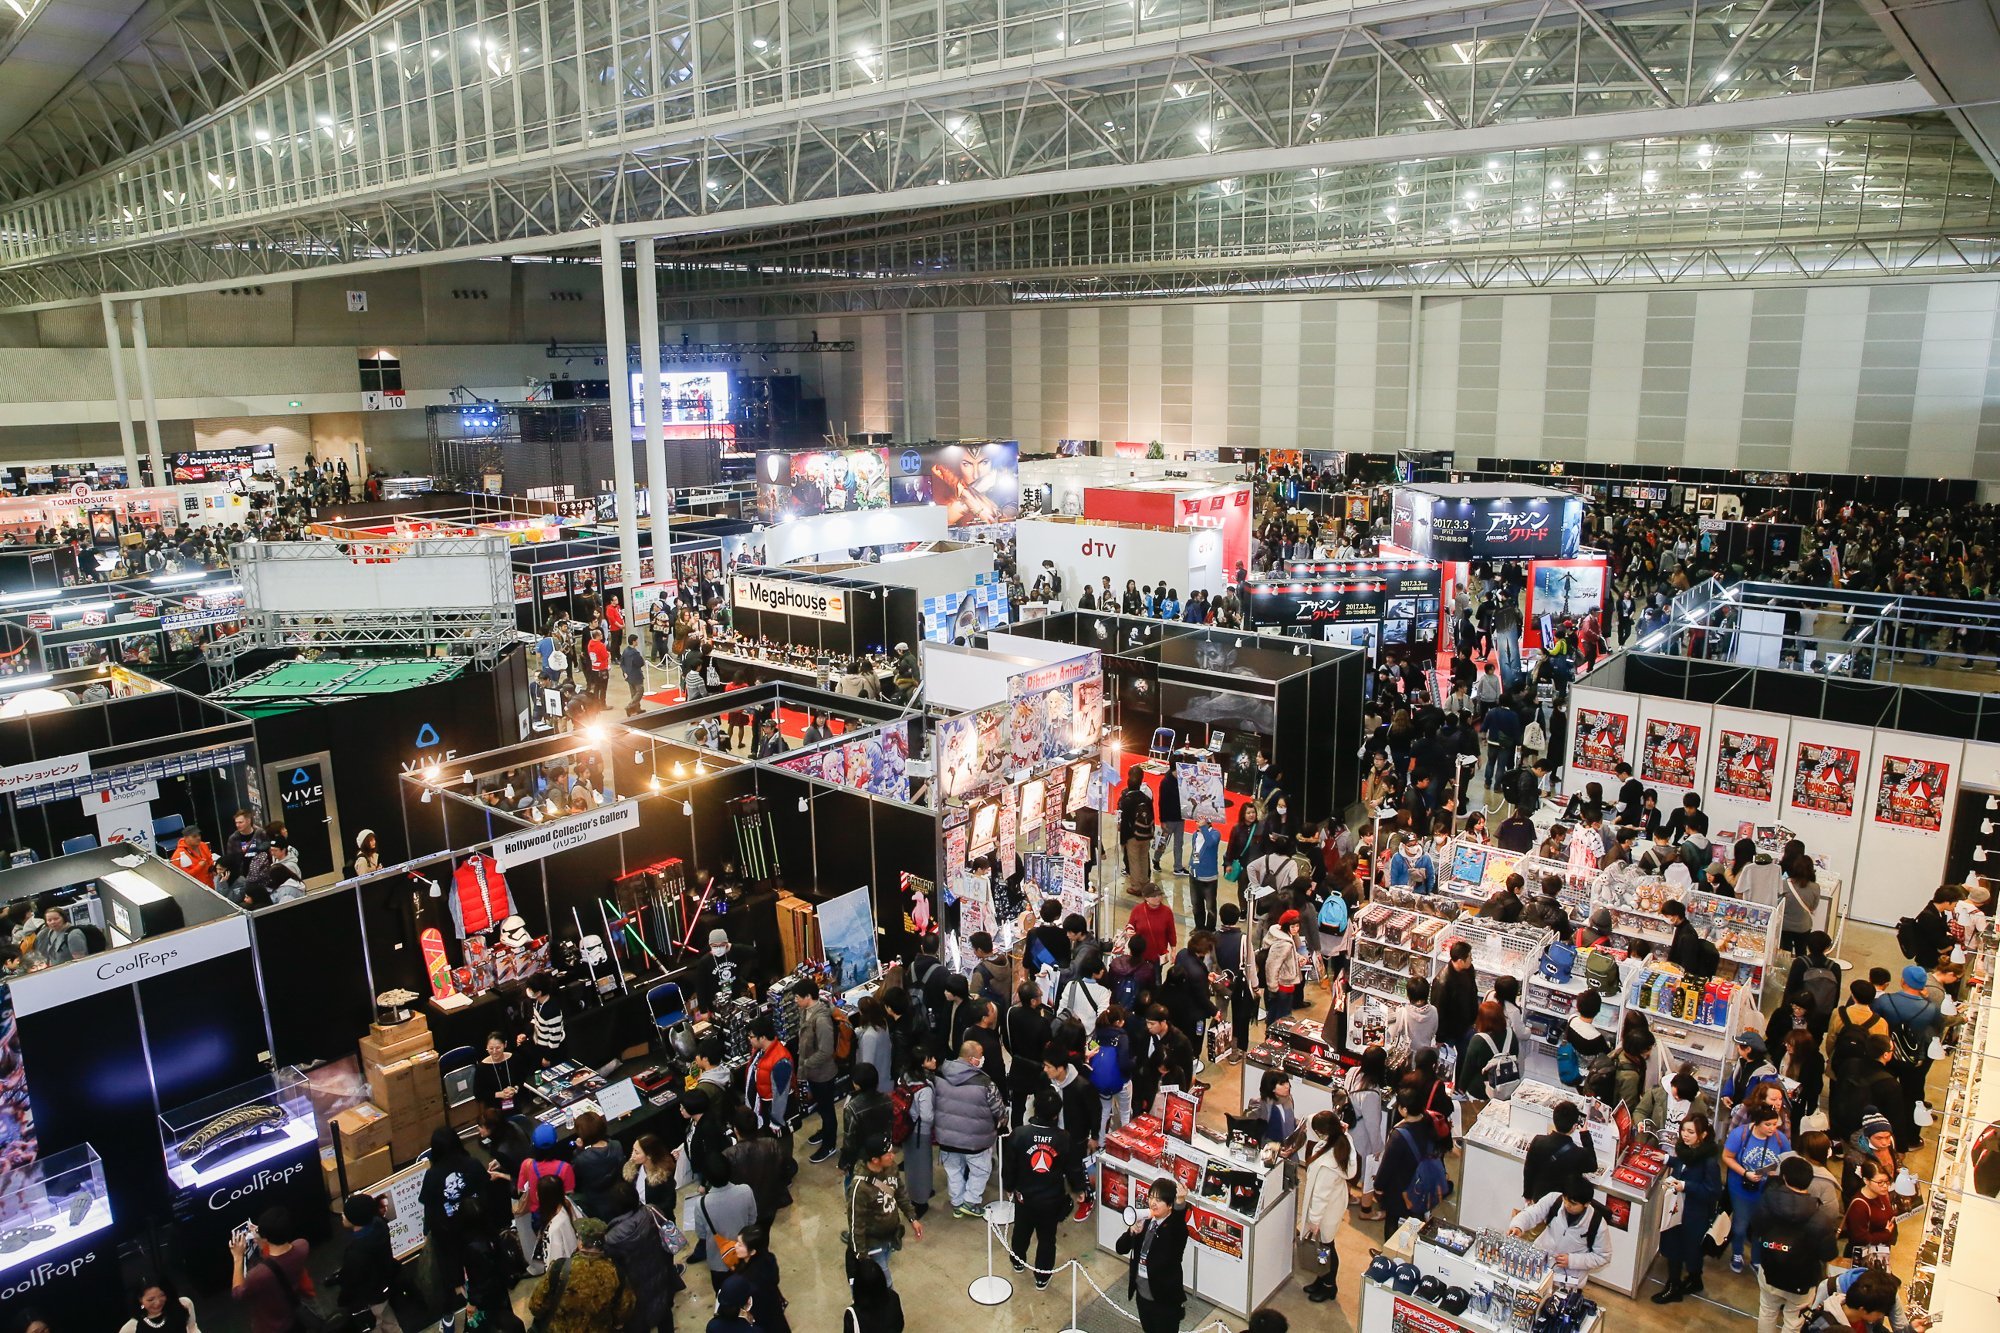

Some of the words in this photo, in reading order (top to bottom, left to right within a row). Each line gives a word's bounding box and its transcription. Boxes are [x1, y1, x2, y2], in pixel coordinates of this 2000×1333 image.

[388, 396, 402, 408] 10
[190, 456, 228, 465] Domino's
[229, 455, 252, 463] Pizza
[901, 456, 920, 470] DC
[52, 496, 114, 506] TOMENOSUKE
[1433, 518, 1469, 530] 2017.3.3
[1486, 512, 1549, 534] アサシン
[1510, 528, 1548, 542] クリード
[1082, 538, 1116, 559] dTV
[750, 582, 827, 611] MegaHouse
[1296, 600, 1340, 616] アサシン
[1312, 610, 1340, 620] クリード
[85, 613, 104, 625] 8%
[1060, 664, 1084, 680] Anime
[0, 763, 79, 786] ネットショッピング
[113, 788, 146, 800] shopping
[282, 784, 322, 802] VIVE
[504, 832, 551, 854] Hollywood
[552, 818, 598, 840] Collector's
[600, 809, 628, 825] Gallery
[96, 946, 178, 981] CoolProps
[1324, 1050, 1340, 1060] TOKYO
[208, 1160, 304, 1210] CoolProps
[0, 1250, 96, 1301] oolProps
